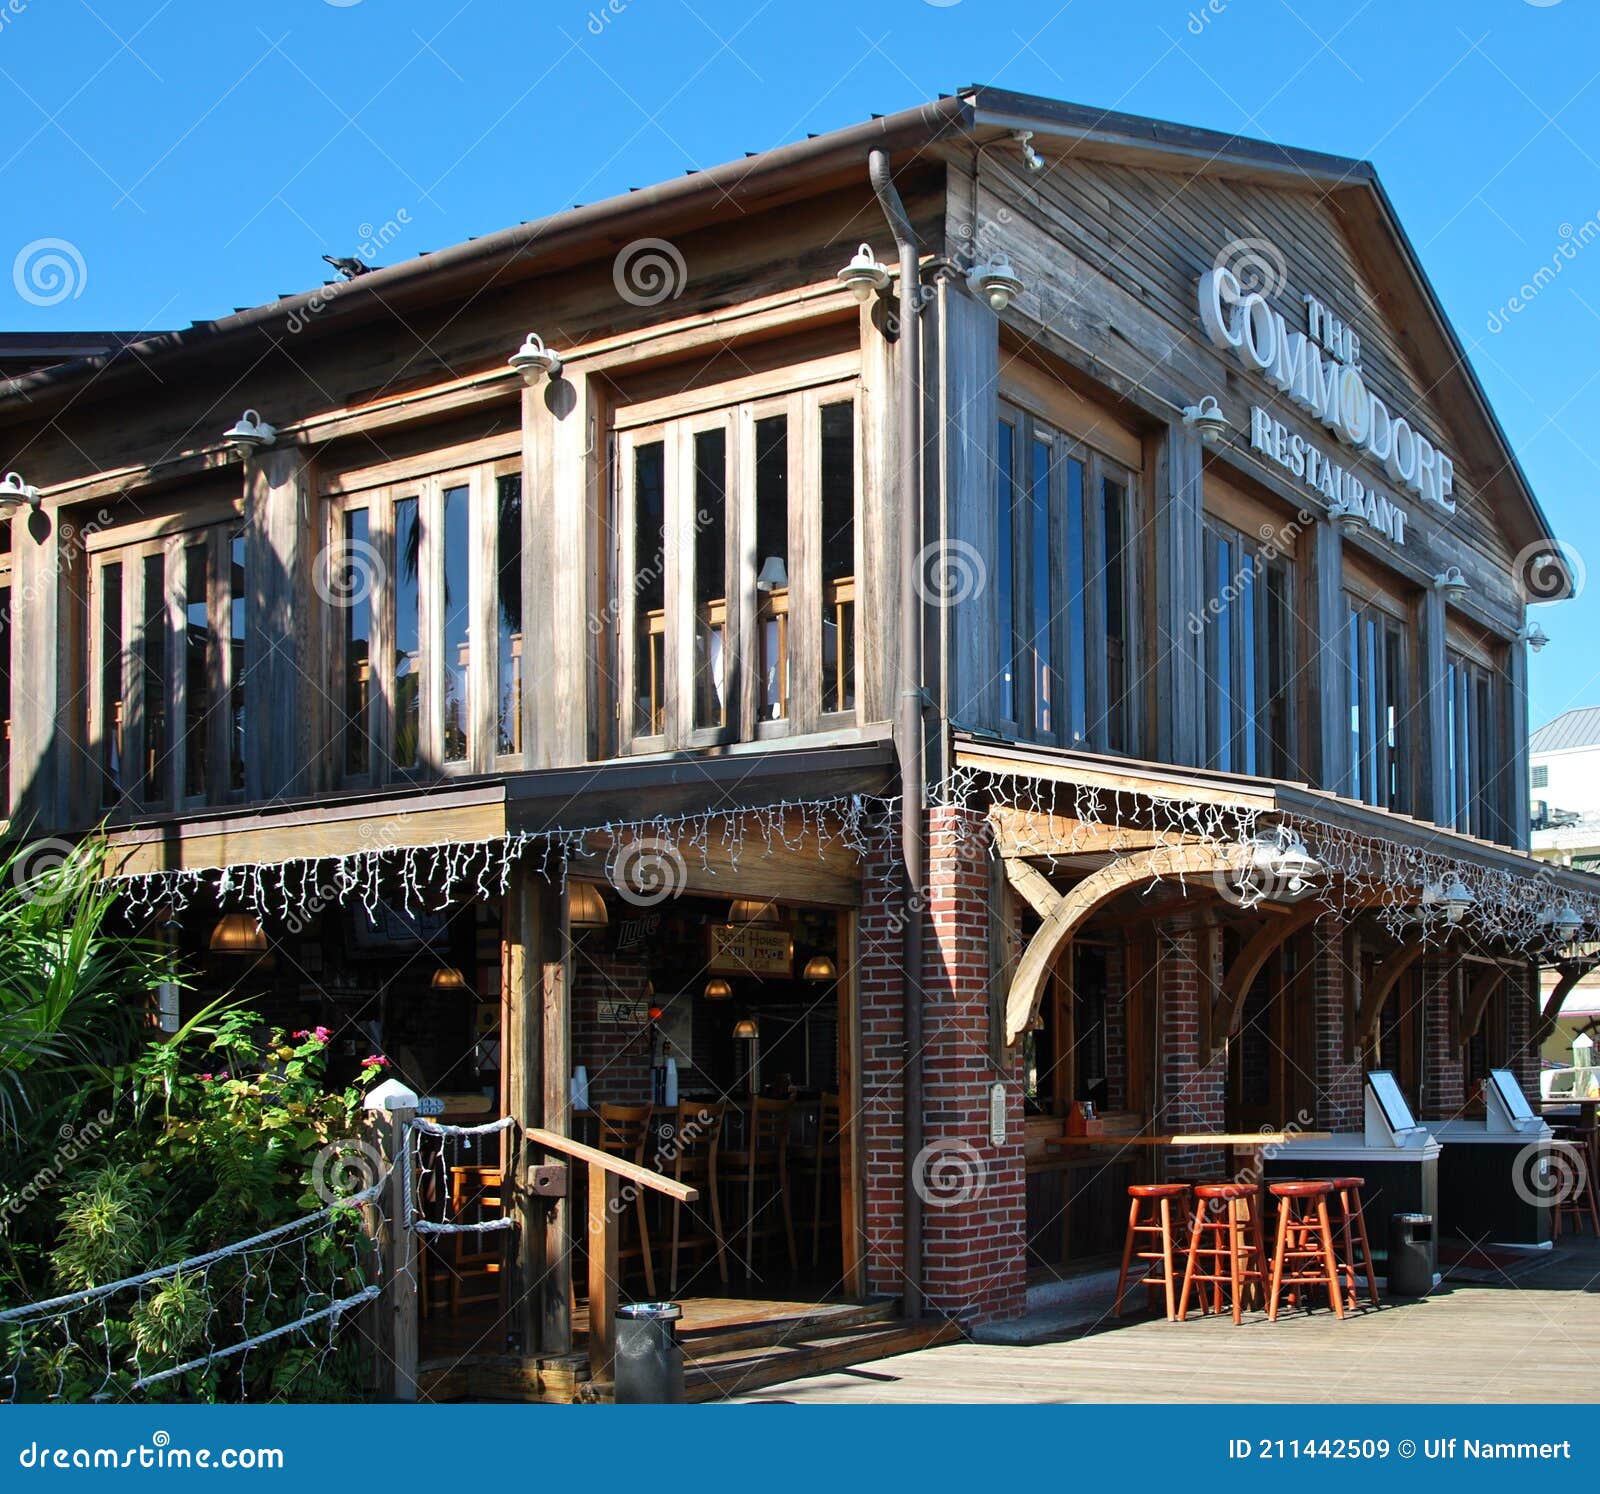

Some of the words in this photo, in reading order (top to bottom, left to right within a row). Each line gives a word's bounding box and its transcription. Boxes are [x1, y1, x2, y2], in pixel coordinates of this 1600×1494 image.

[1198, 266, 1457, 515] COMMODORE
[1303, 294, 1362, 372] THE
[1250, 406, 1408, 546] RESTAURANT
